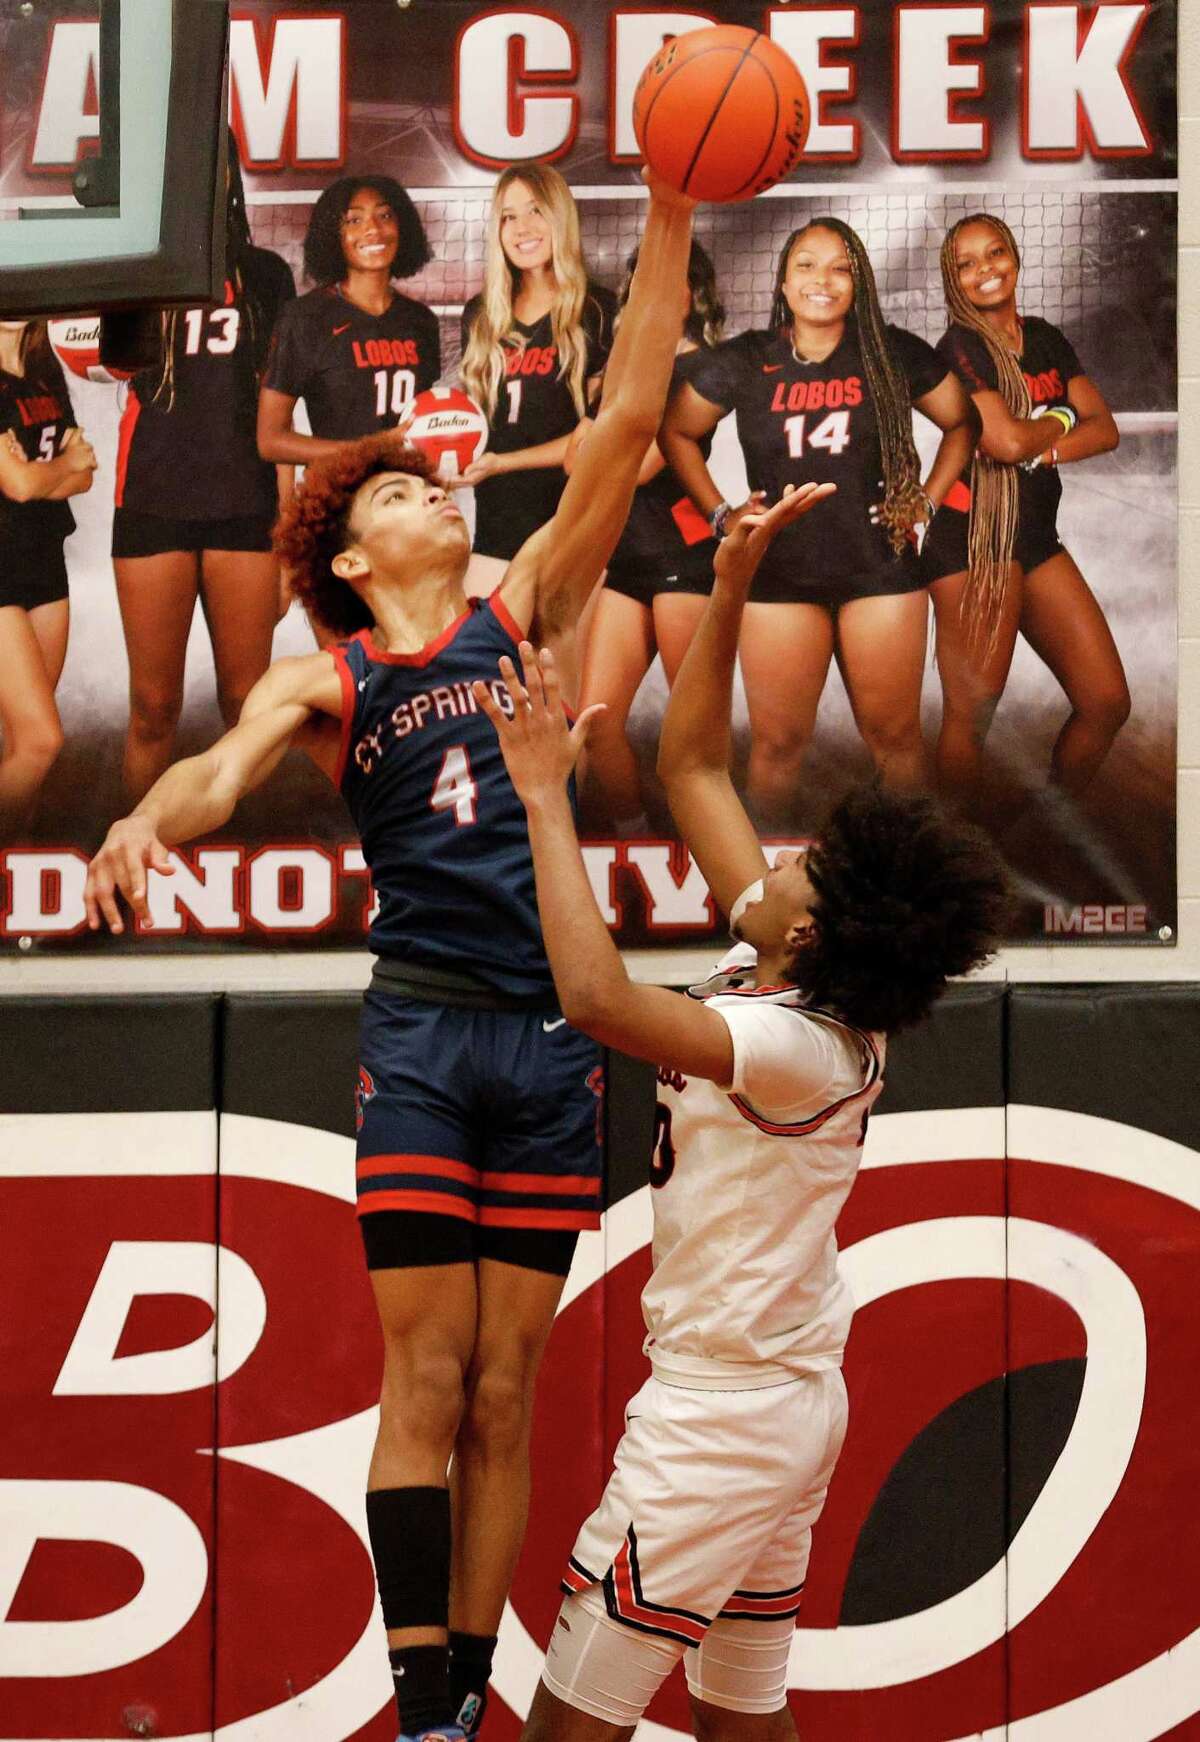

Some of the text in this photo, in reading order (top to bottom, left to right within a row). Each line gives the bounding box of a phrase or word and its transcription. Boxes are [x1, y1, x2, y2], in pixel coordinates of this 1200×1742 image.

[64, 326, 100, 342] Bad
[184, 306, 240, 355] 13
[352, 338, 420, 369] LOBOS
[374, 369, 416, 417] 10
[506, 378, 523, 425] 1
[770, 376, 864, 413] LOBOS
[36, 424, 57, 463] 5
[783, 409, 851, 459] 14
[430, 743, 480, 828] 4
[138, 846, 380, 932] NO
[1043, 904, 1148, 933] IM2GE
